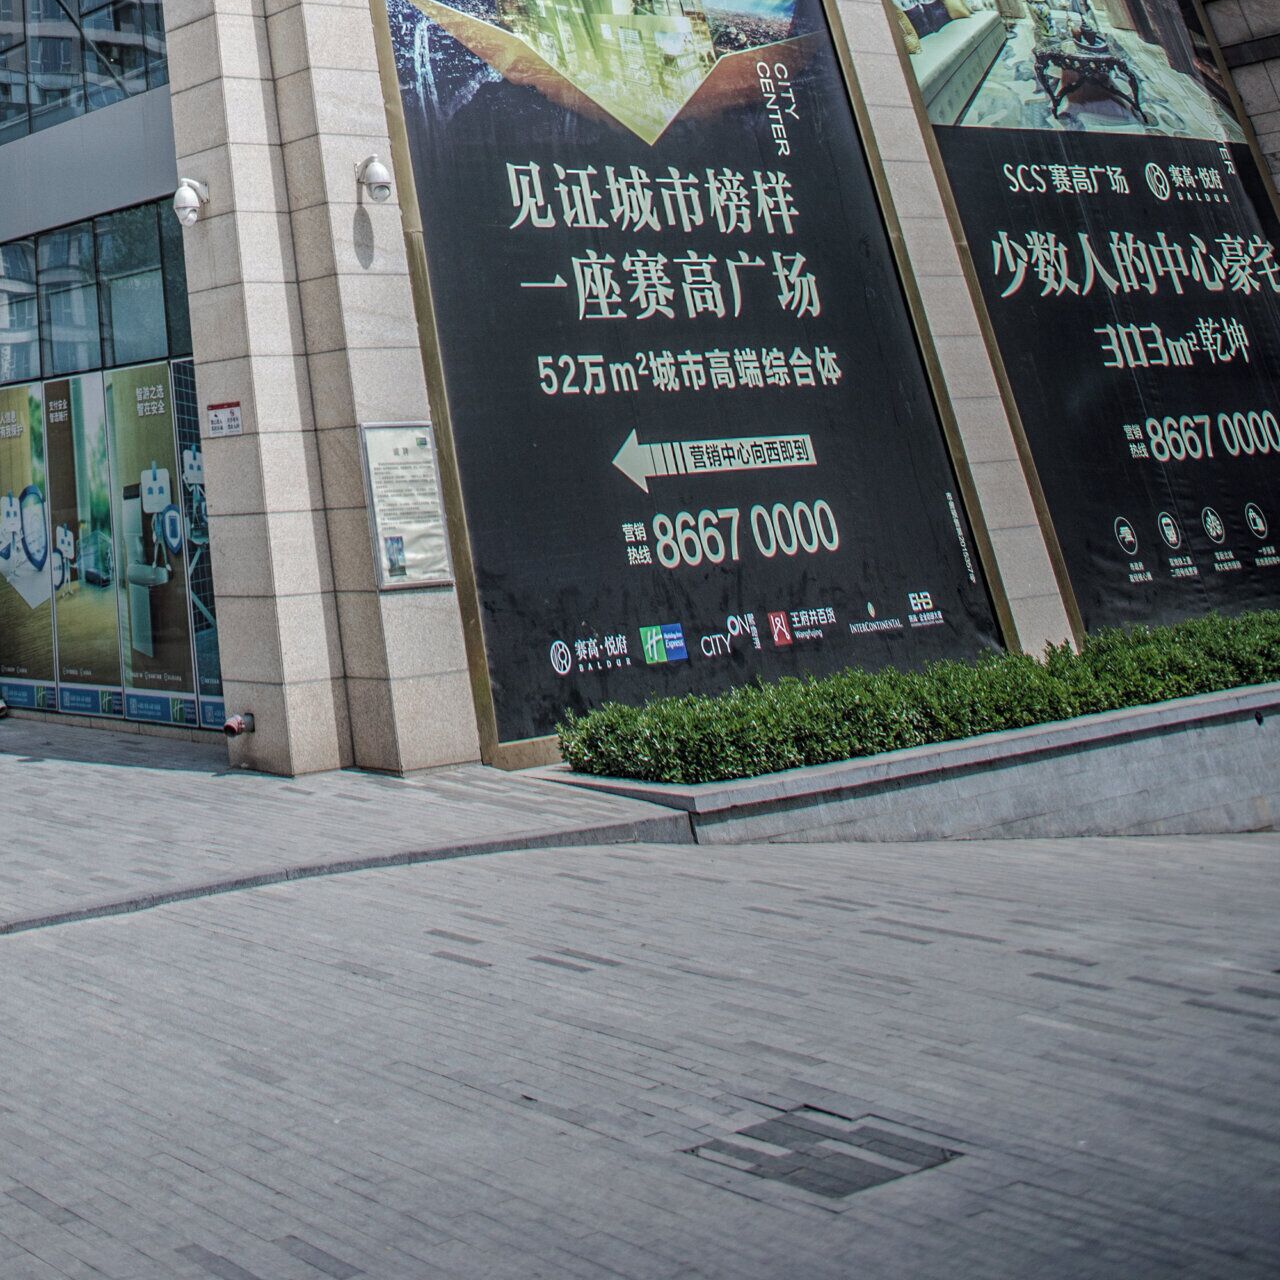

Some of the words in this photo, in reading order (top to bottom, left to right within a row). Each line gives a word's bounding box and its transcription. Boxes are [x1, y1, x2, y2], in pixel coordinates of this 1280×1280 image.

[756, 62, 790, 156] CENTER
[774, 63, 799, 119] CITY
[506, 161, 799, 234] 见证城市榜样
[1050, 164, 1130, 194] 赛高广场
[521, 249, 820, 320] 一座赛高广场
[991, 230, 1280, 298] 少数人的中心豪宅
[689, 438, 810, 469] 营销中心向西即到
[1145, 417, 1214, 462] 8667
[1217, 410, 1280, 456] 0000
[622, 522, 647, 542] 营销
[627, 545, 652, 565] 热线
[653, 513, 739, 568] 8667
[751, 499, 839, 557] 0000
[701, 633, 731, 657] CITY
[727, 614, 751, 636] ON
[790, 607, 837, 627] 王府井百货
